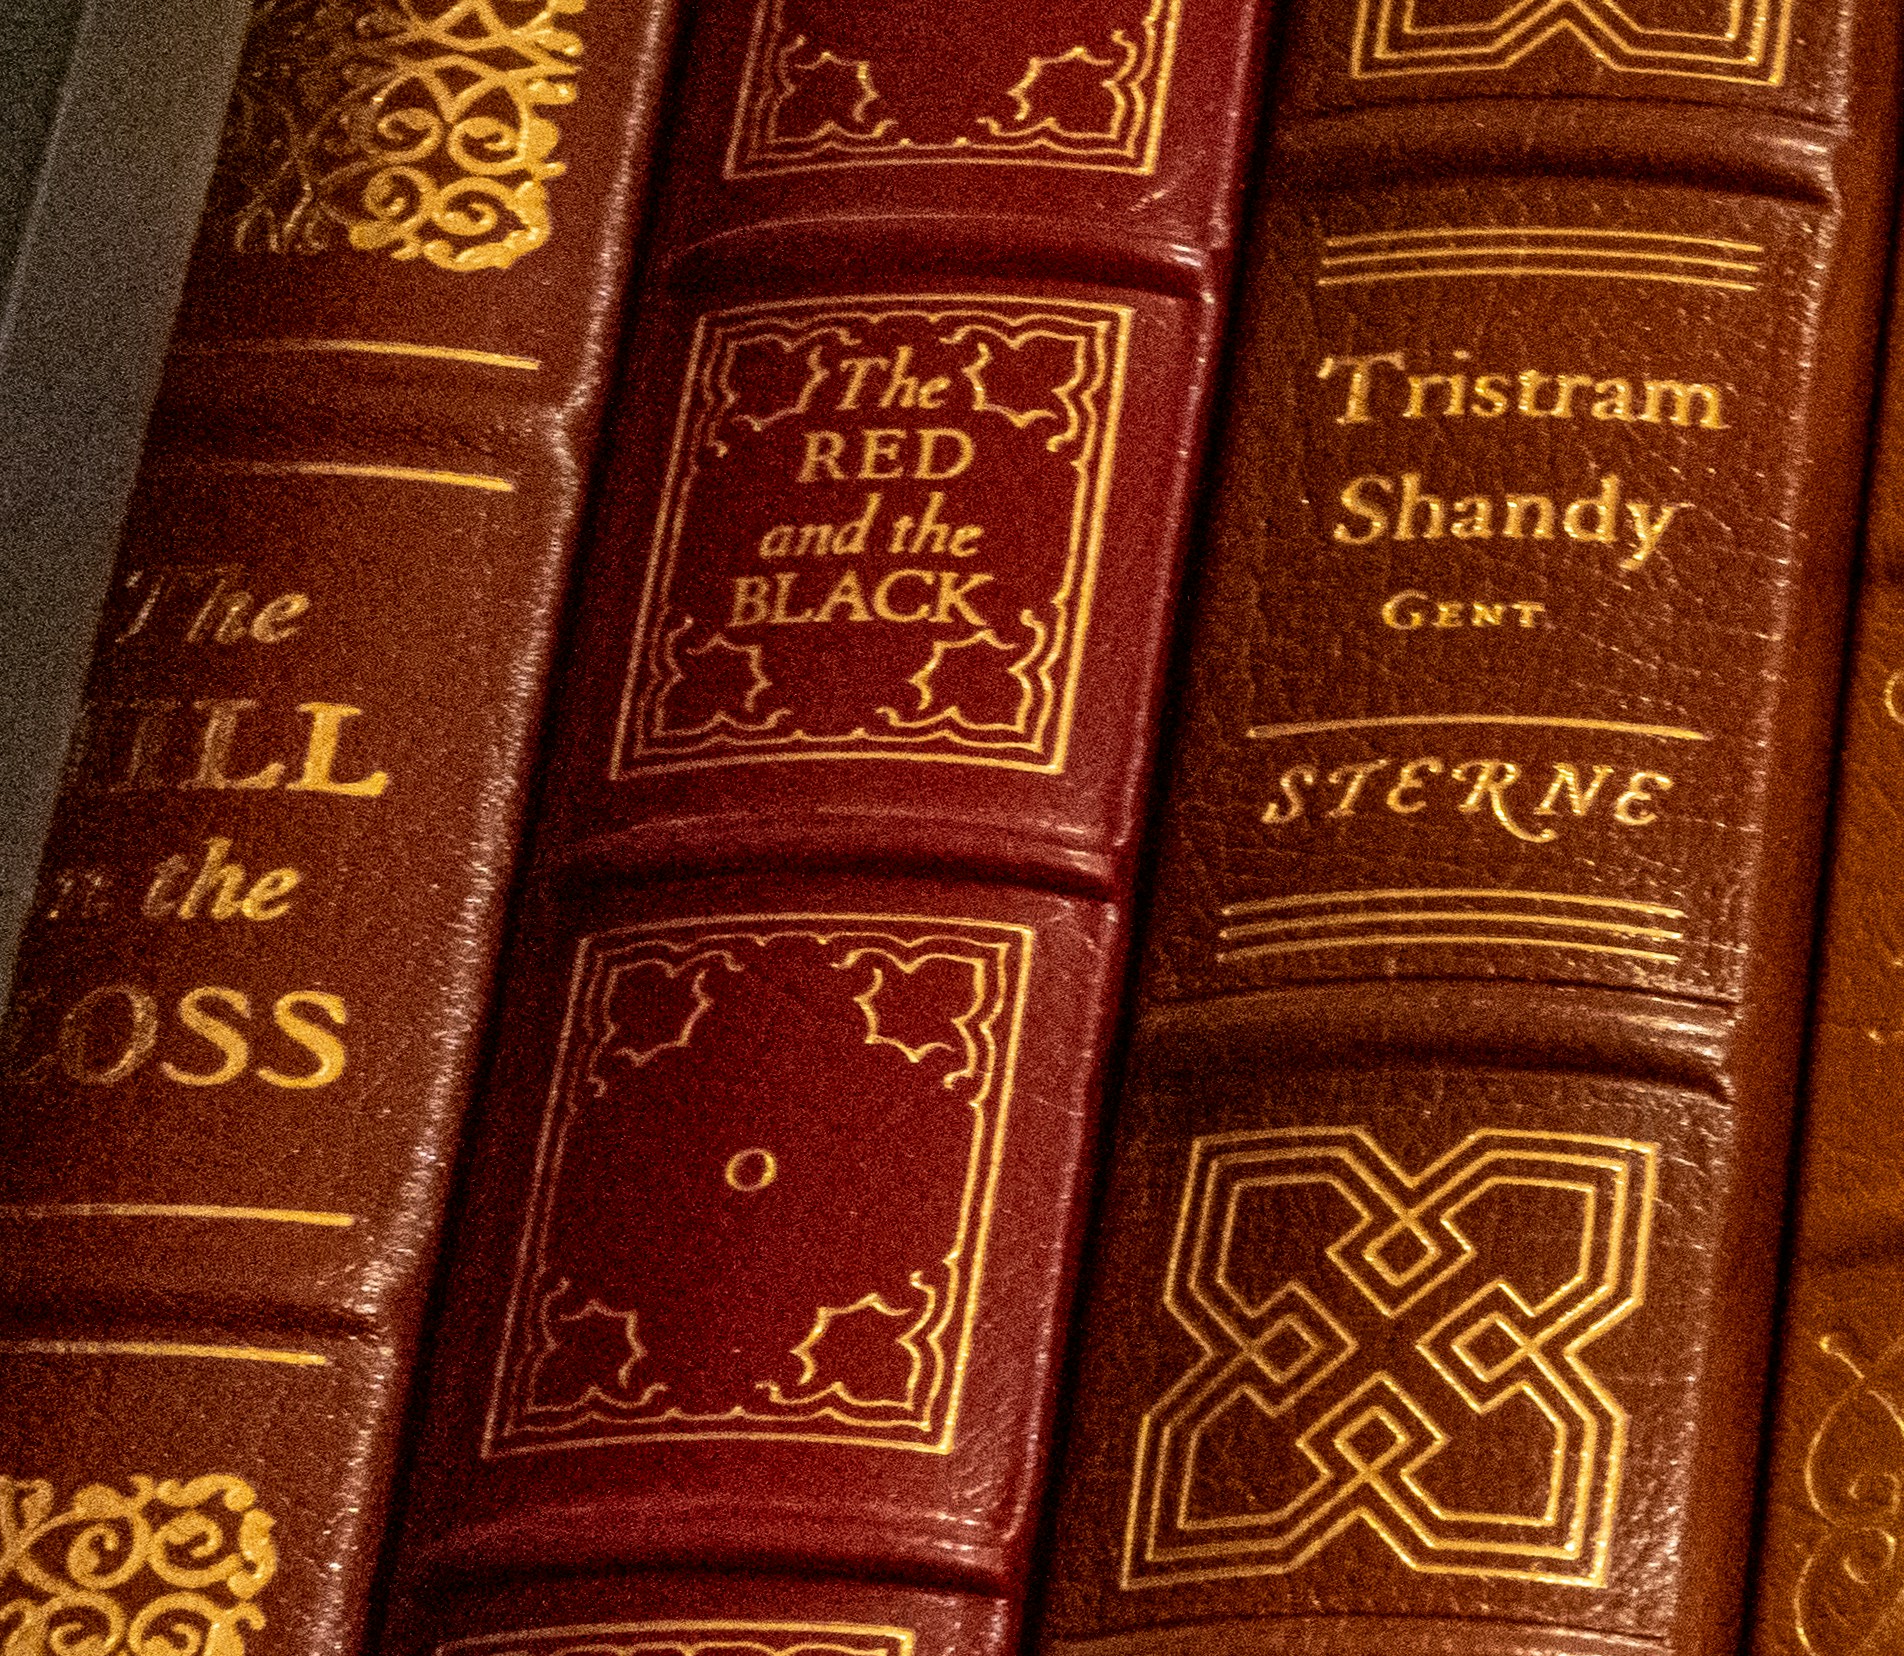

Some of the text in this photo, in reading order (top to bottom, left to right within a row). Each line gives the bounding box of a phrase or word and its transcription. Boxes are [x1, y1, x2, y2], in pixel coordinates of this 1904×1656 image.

[836, 345, 951, 411] The
[1316, 349, 1731, 430] Tristram
[796, 427, 975, 484] RED
[758, 491, 985, 559] and the
[1332, 471, 1696, 571] Shandy
[726, 568, 995, 628] BLACK
[80, 698, 390, 799] ILL
[1261, 757, 1672, 844] STERNE
[143, 837, 301, 922] the
[52, 984, 348, 1089] OSS
